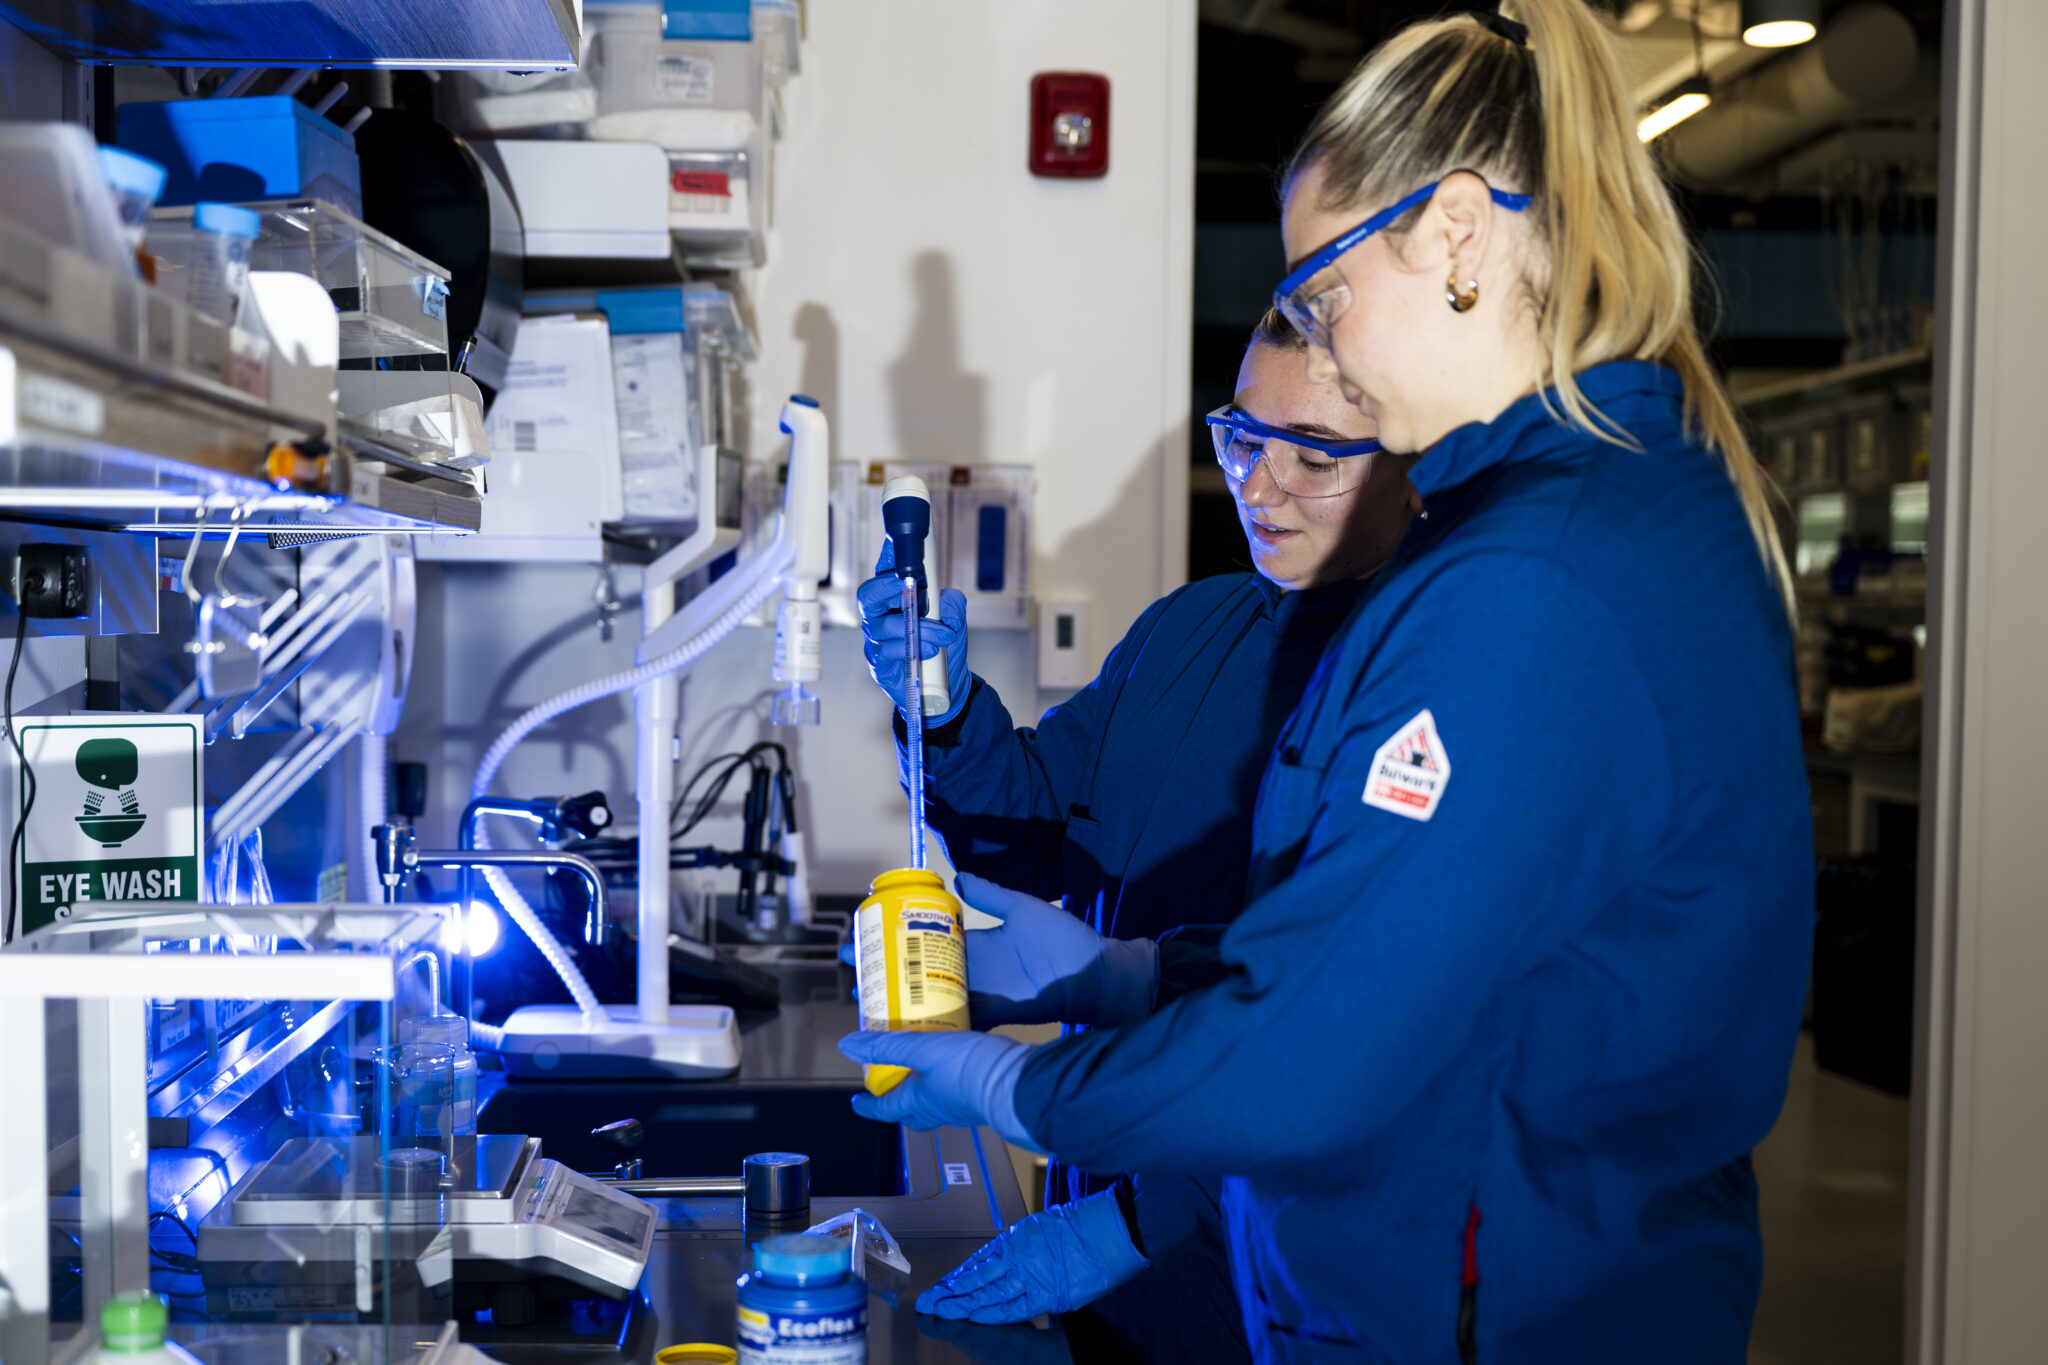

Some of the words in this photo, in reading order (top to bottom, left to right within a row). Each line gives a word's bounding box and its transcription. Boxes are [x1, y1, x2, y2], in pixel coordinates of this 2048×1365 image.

[40, 873, 90, 903] EYE
[102, 869, 181, 900] WASH
[778, 1317, 855, 1337] Ecoflex
